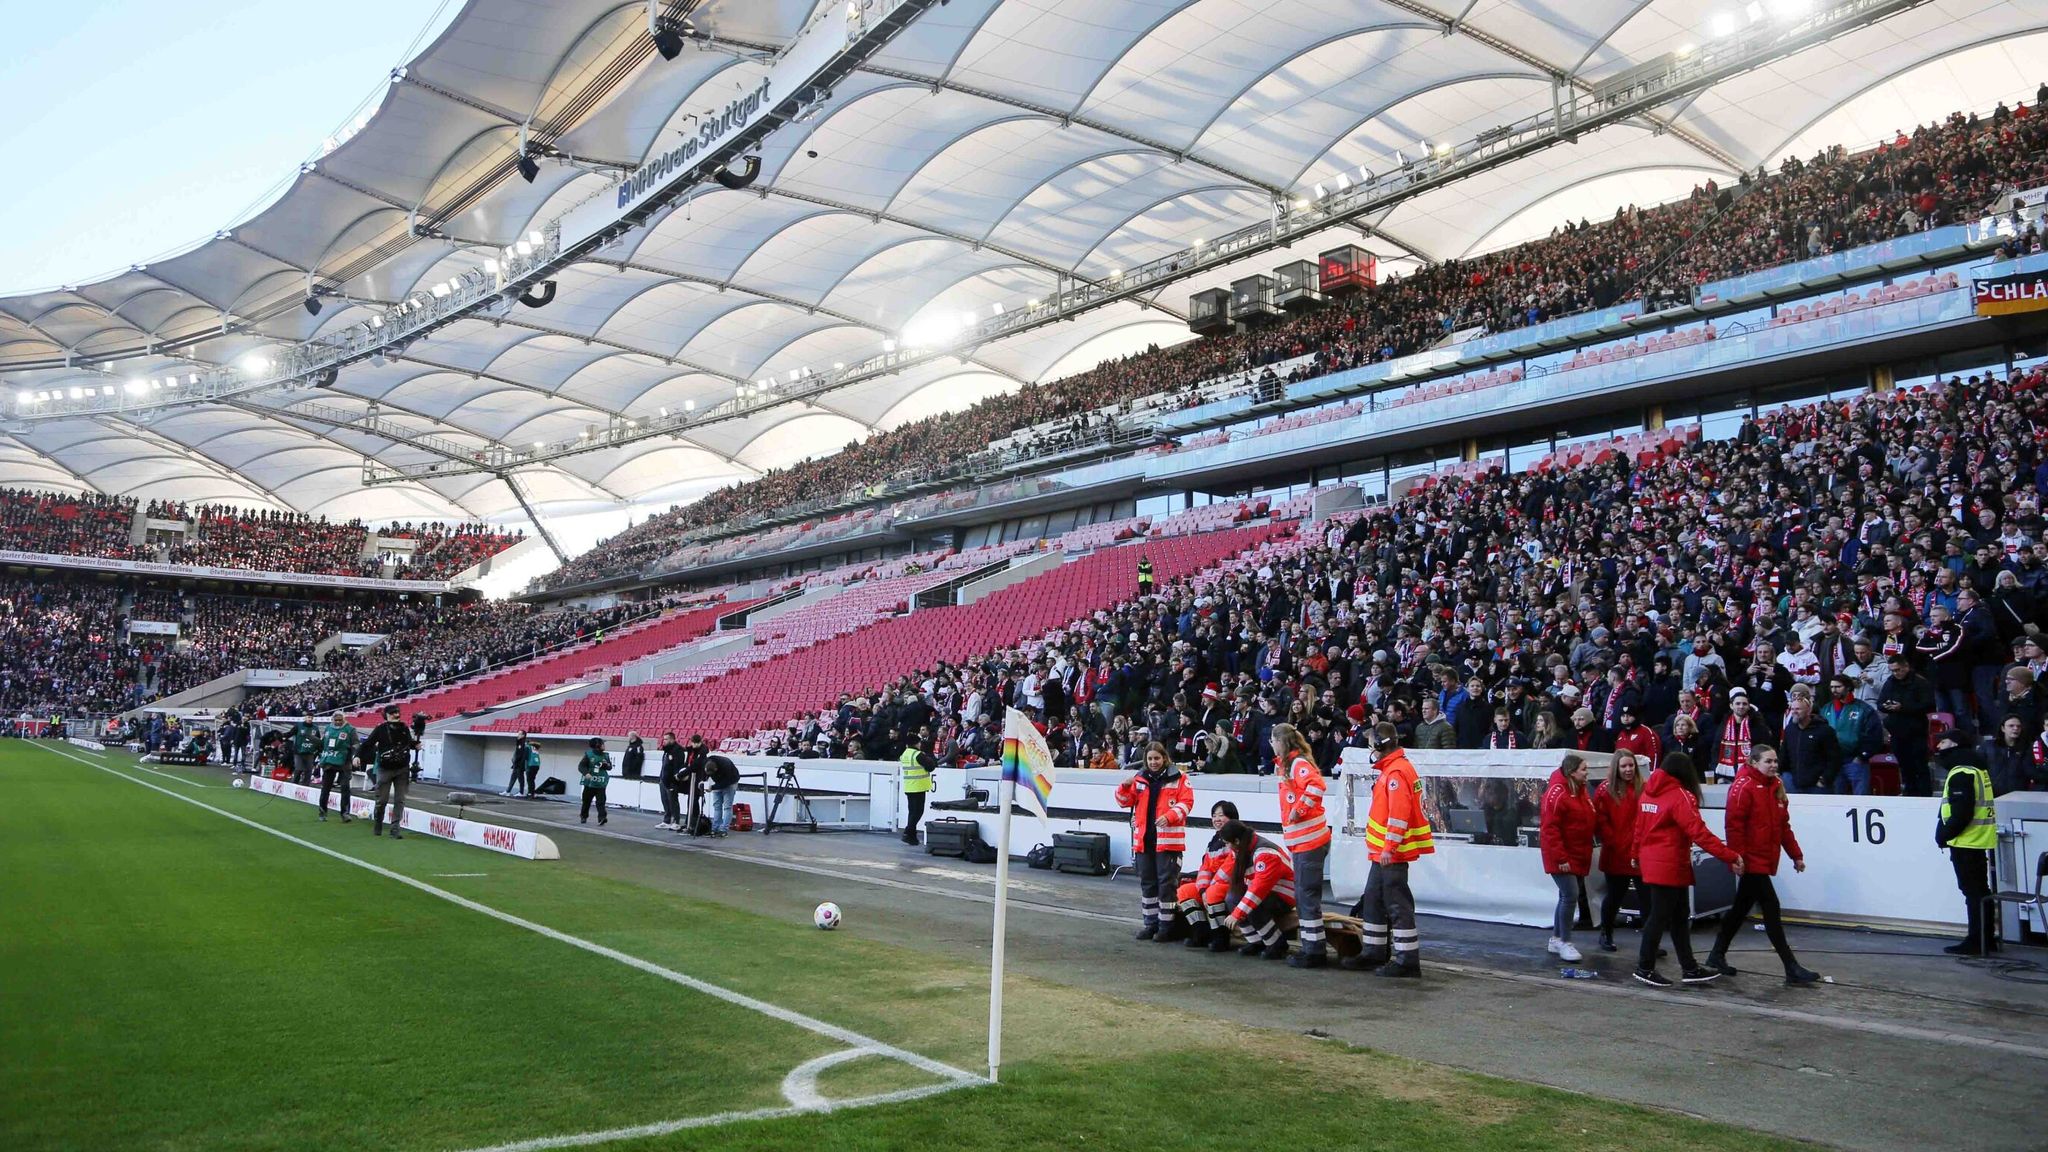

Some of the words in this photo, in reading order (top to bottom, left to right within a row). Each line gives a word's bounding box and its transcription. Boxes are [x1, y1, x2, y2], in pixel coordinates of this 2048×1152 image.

[699, 77, 771, 149] Stuttgart
[2023, 191, 2043, 201] MHP
[1977, 278, 2048, 300] SCHLÄ
[429, 815, 457, 840] WINAMAX
[1846, 807, 1886, 845] 16
[483, 826, 517, 852] WINAMAX
